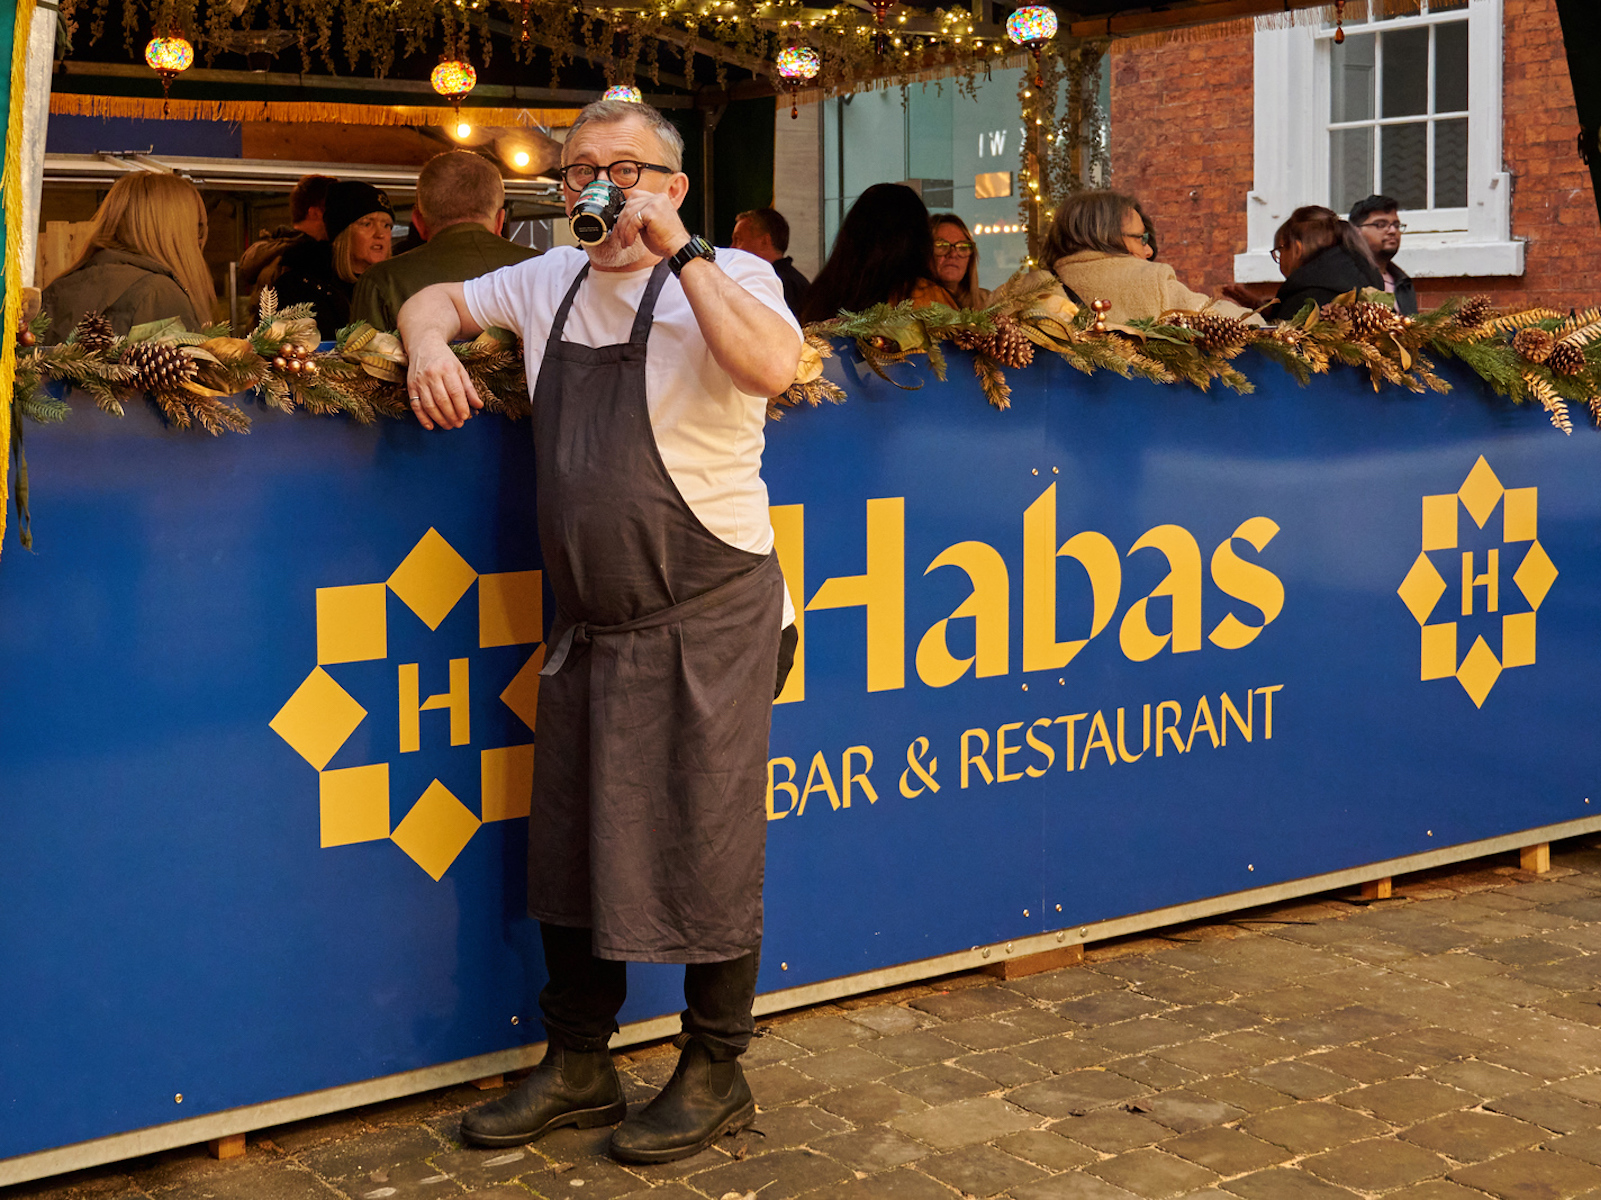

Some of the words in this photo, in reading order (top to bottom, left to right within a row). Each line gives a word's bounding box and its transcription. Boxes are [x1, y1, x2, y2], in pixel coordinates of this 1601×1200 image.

[768, 481, 1285, 705] Habas
[1461, 548, 1499, 616] H
[398, 657, 471, 753] H
[765, 745, 879, 821] BAR
[898, 736, 941, 799] &
[960, 684, 1285, 789] RESTAURANT
